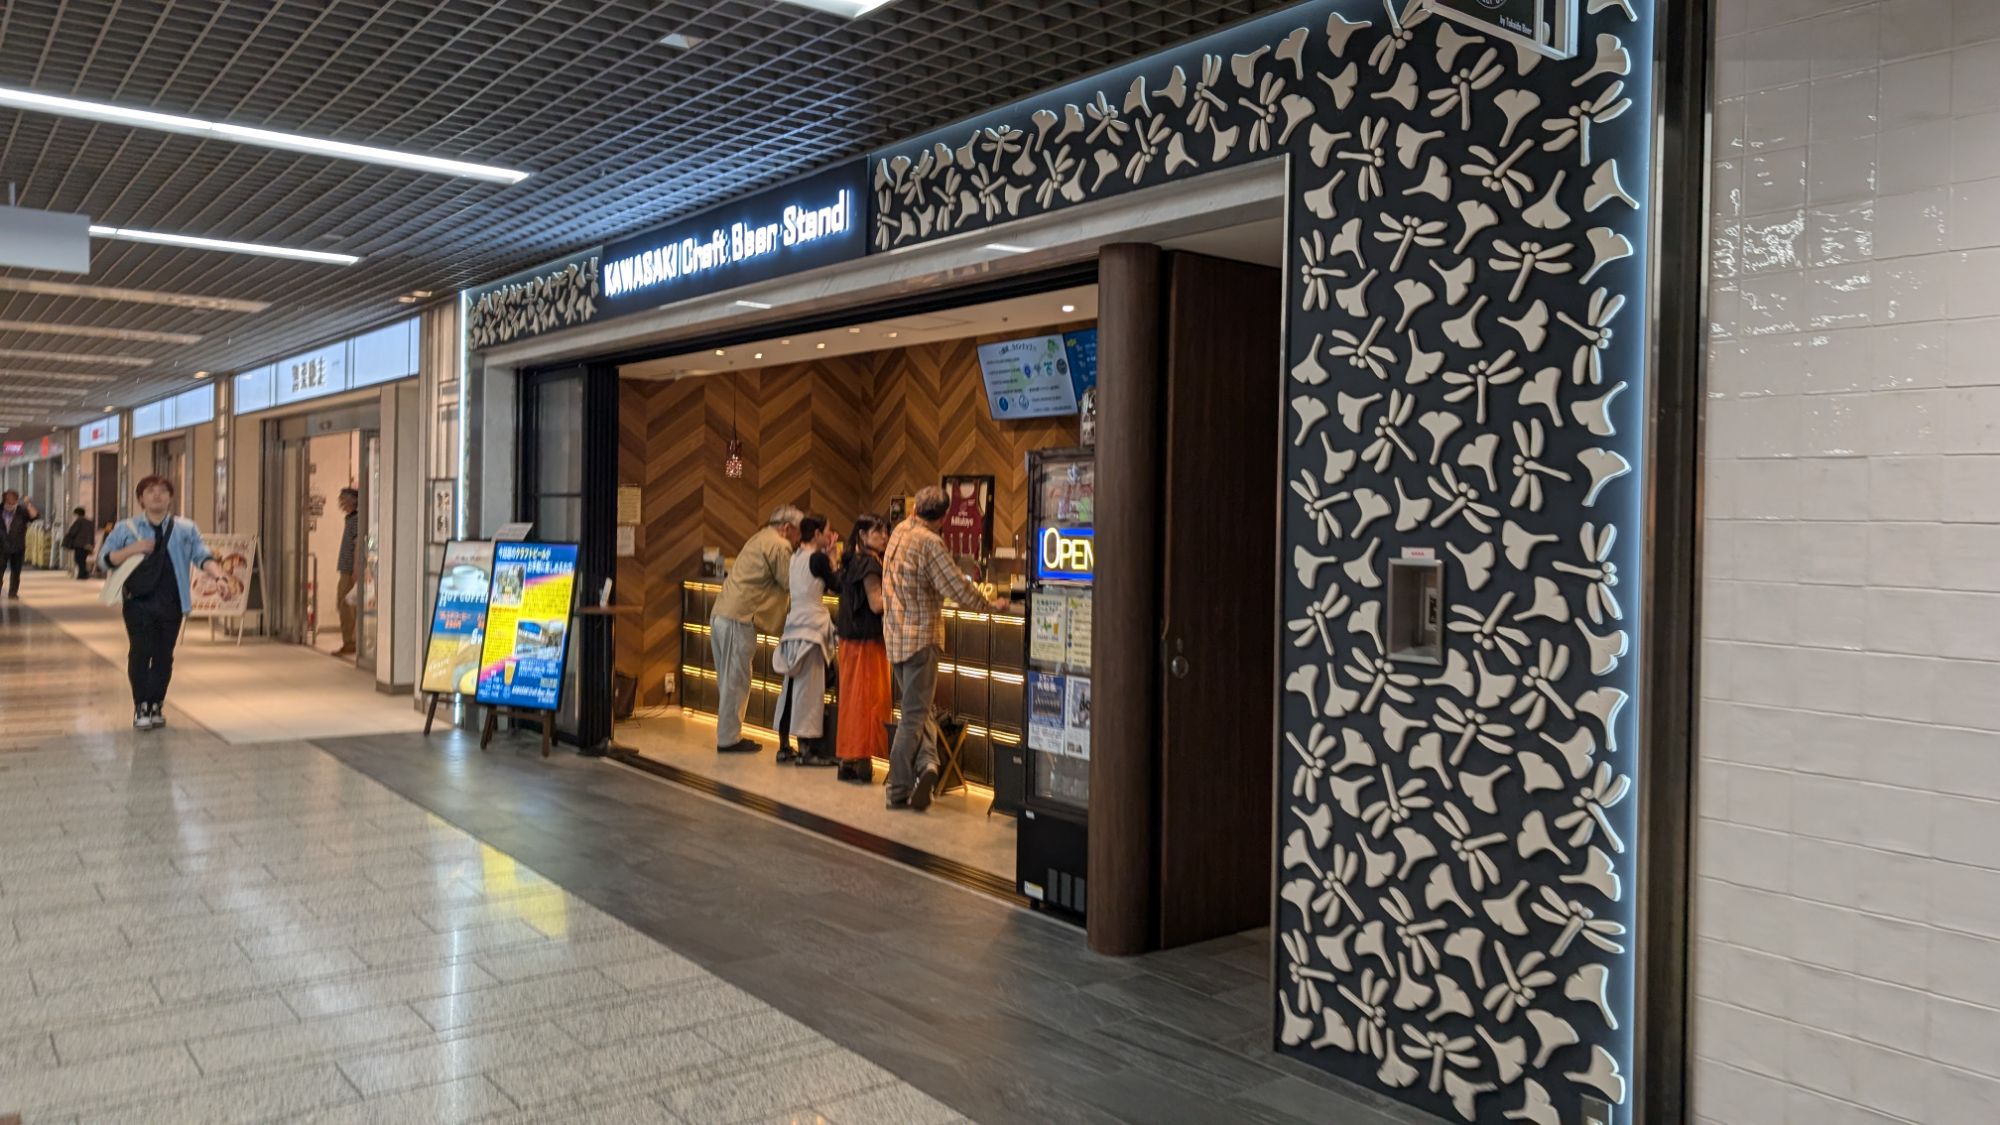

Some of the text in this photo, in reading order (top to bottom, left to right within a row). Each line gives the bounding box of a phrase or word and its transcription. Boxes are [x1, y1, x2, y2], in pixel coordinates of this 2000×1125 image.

[604, 188, 849, 298] KAWASAKI Craft Beer Stand
[438, 591, 458, 607] HOT
